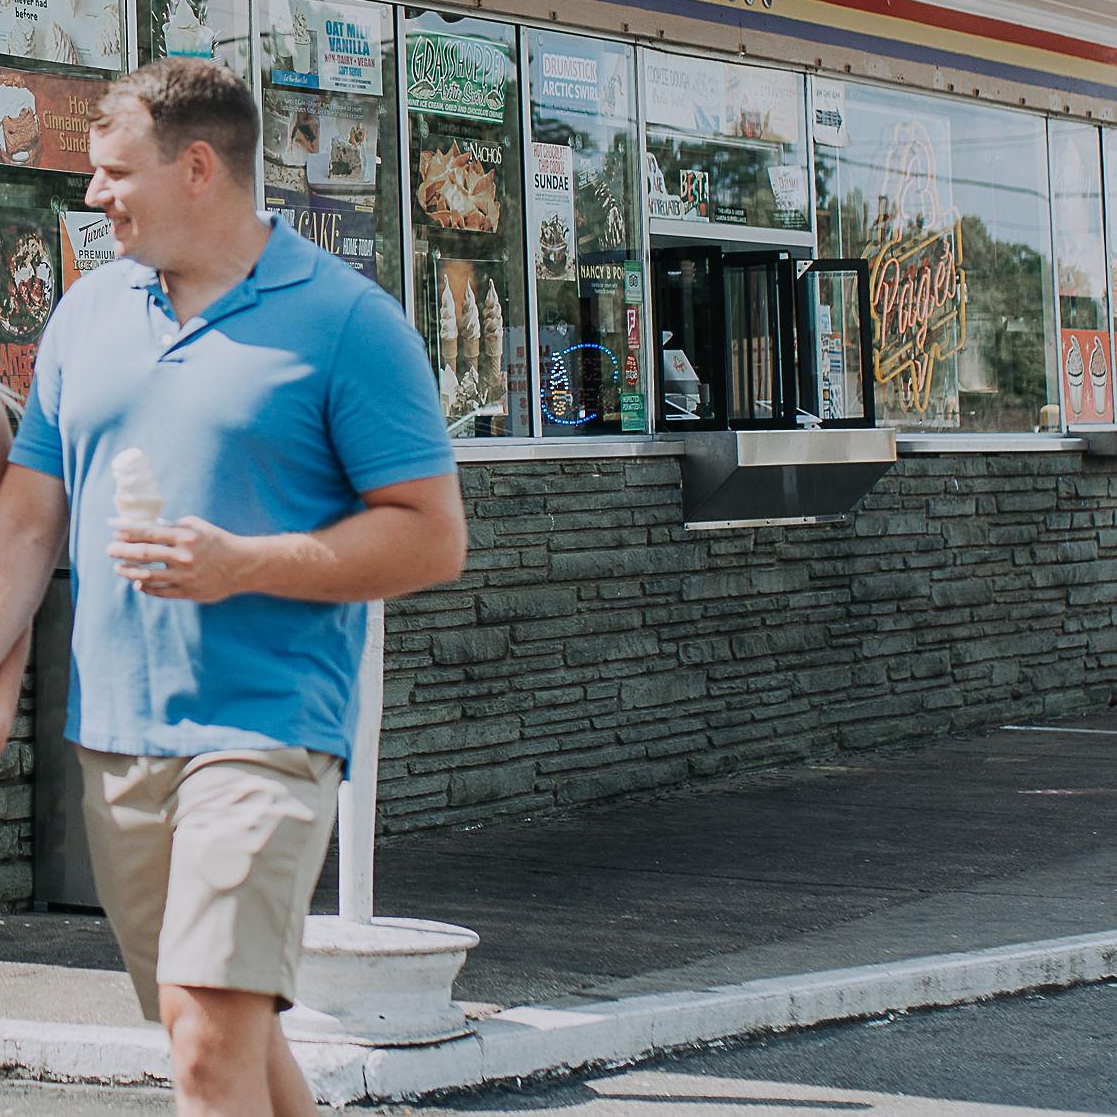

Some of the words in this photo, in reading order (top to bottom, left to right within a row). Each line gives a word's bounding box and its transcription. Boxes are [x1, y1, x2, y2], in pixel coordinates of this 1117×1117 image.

[15, 7, 38, 21] before
[325, 20, 346, 37] OAT
[347, 23, 371, 40] MILK
[328, 37, 370, 56] VANILLA
[338, 65, 348, 76] SOFT
[348, 66, 362, 77] SERVE
[357, 56, 376, 68] VEGAN
[411, 35, 506, 107] GRASSHOPPER
[544, 56, 596, 80] DRUMSTICK
[542, 80, 573, 99] ARCTIC
[575, 85, 600, 101] SWIRL
[68, 95, 90, 114] Hot
[458, 105, 467, 113] AND
[467, 106, 488, 116] CHOCOLATE
[42, 109, 90, 132] Cinnamo
[59, 134, 90, 153] Sund
[469, 142, 502, 164] NACHOS
[534, 173, 569, 191] SUNDAE
[78, 219, 112, 247] Turner'
[297, 210, 342, 254] CAKE
[78, 249, 115, 259] PREMIUM
[342, 237, 358, 256] HOME
[358, 238, 374, 257] TODAY
[580, 265, 604, 279] NANCY
[606, 266, 611, 279] B
